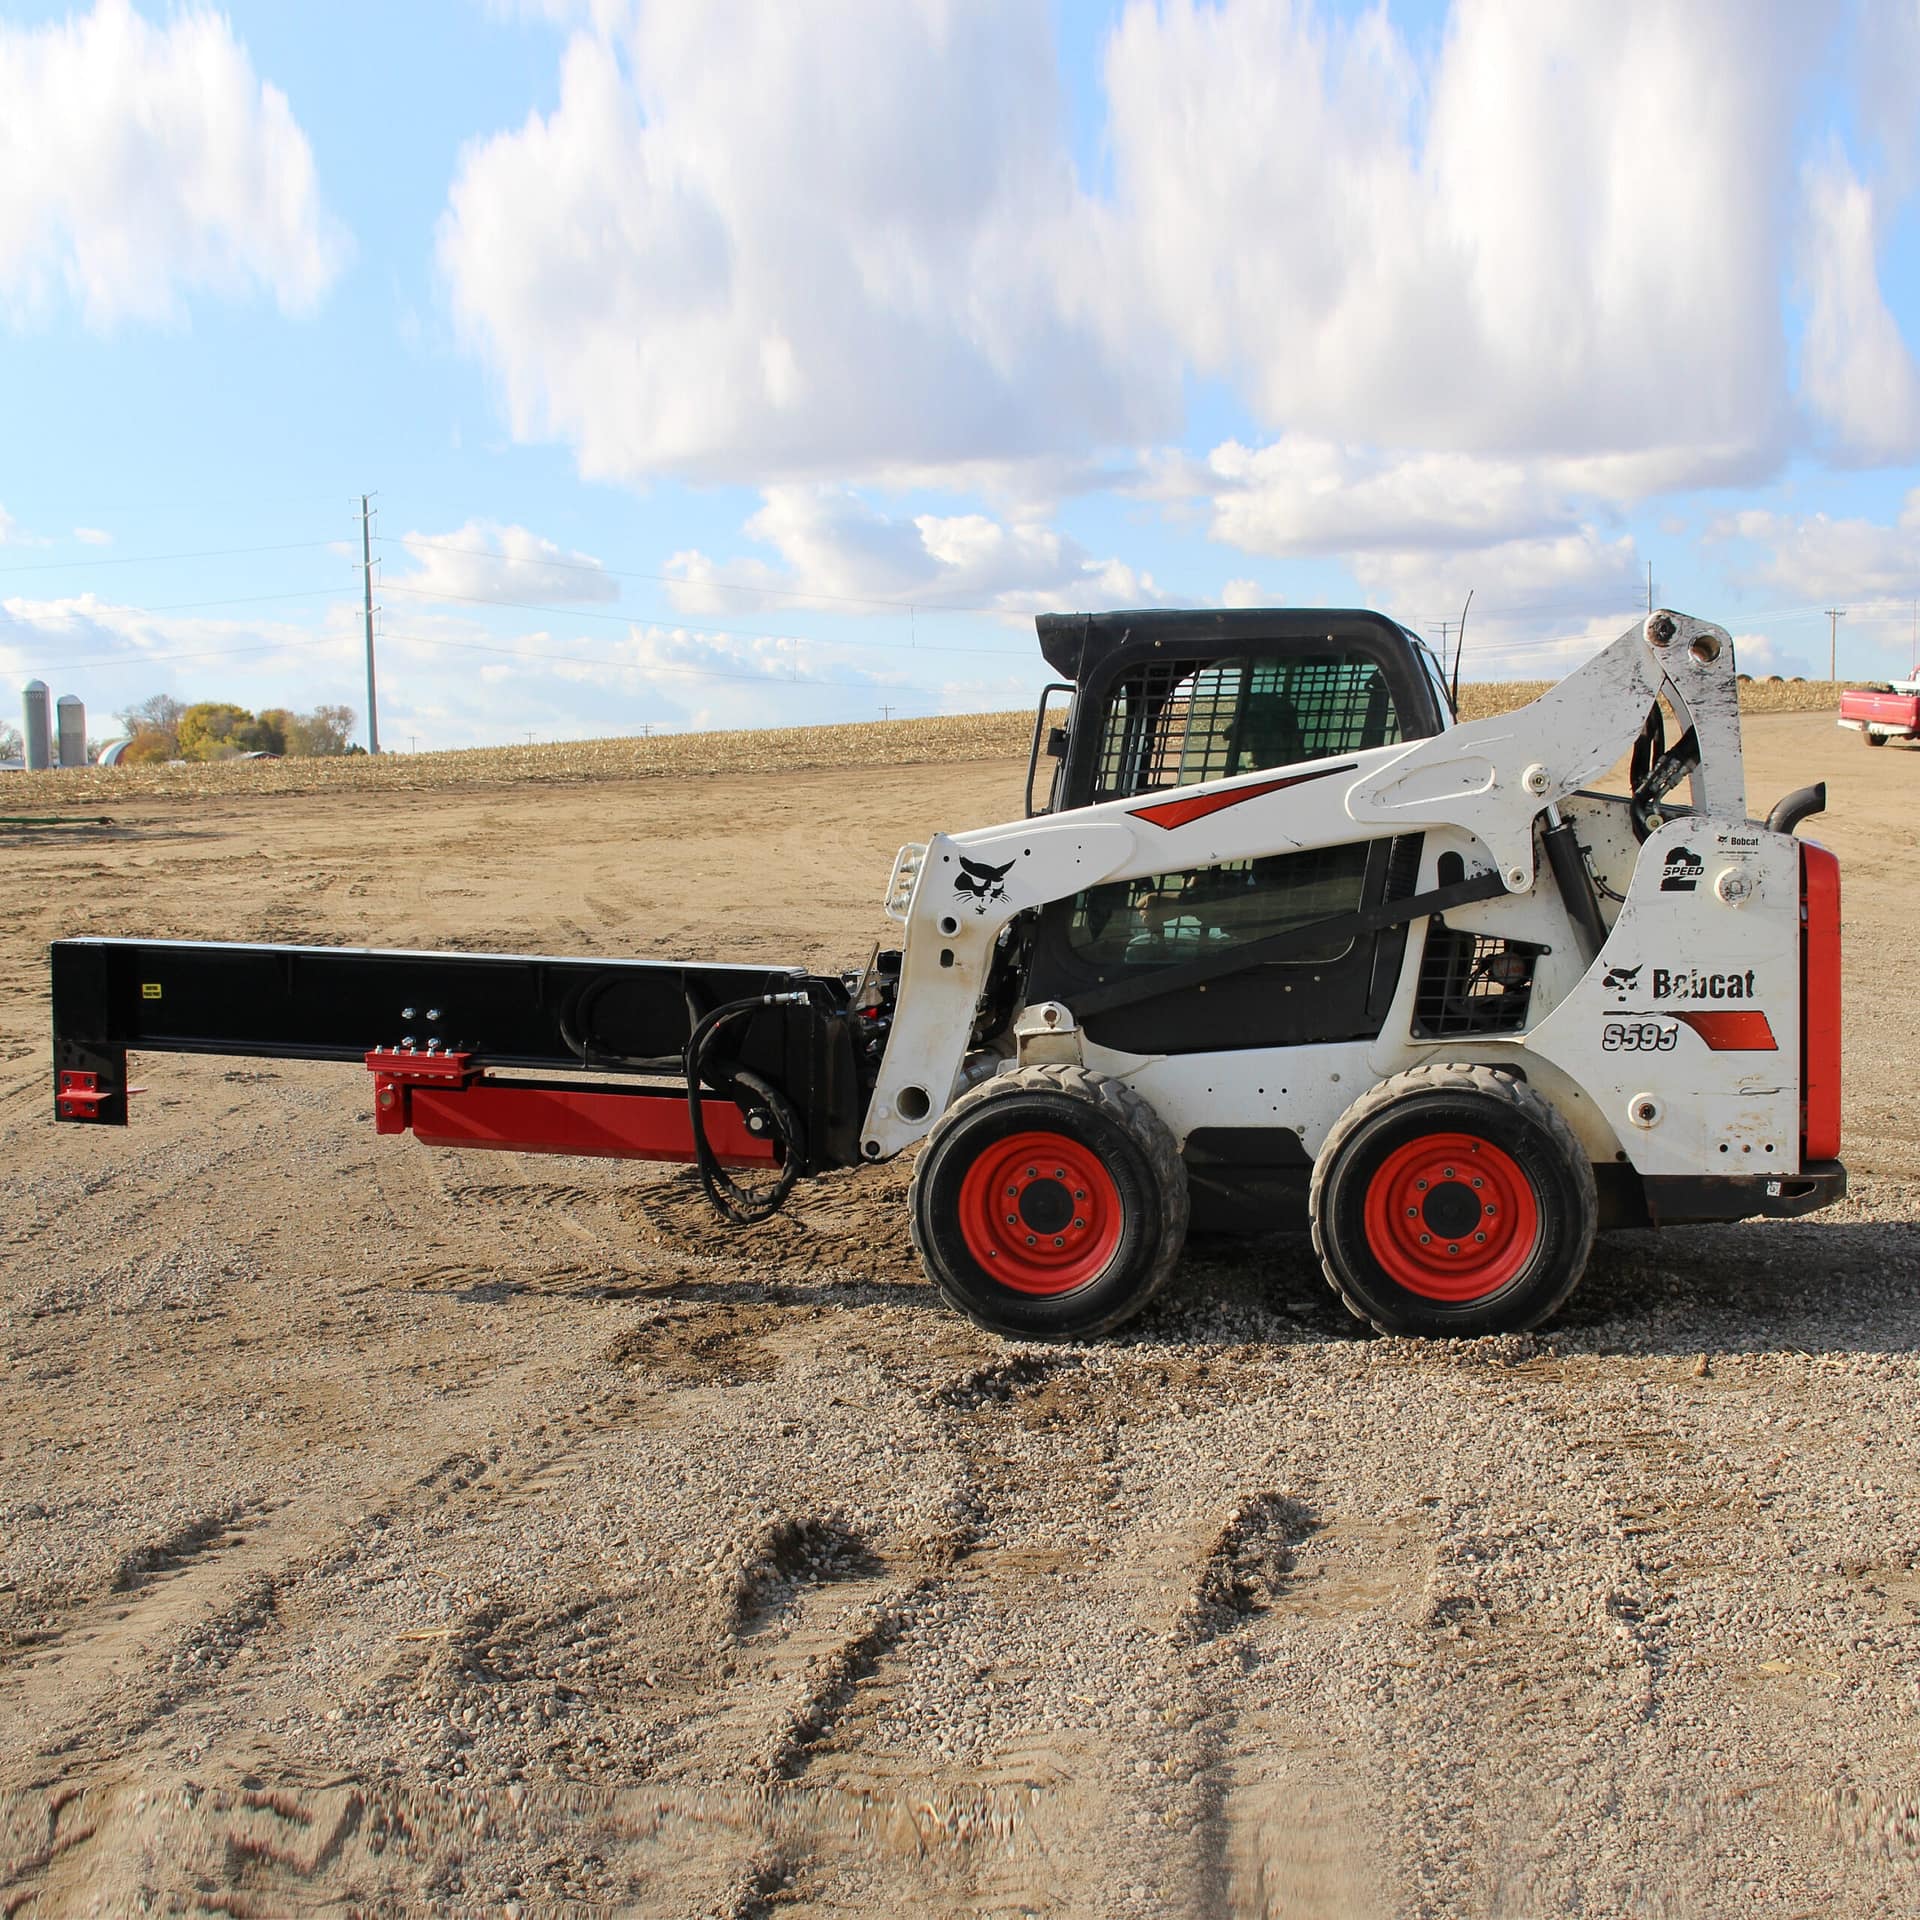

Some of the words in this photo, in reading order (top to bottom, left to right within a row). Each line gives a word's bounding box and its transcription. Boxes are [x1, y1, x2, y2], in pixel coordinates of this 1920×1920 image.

[1731, 837, 1759, 846] Bobcat
[1660, 846, 1702, 892] 2
[1662, 866, 1705, 877] SPEED
[1602, 1023, 1680, 1052] S595
